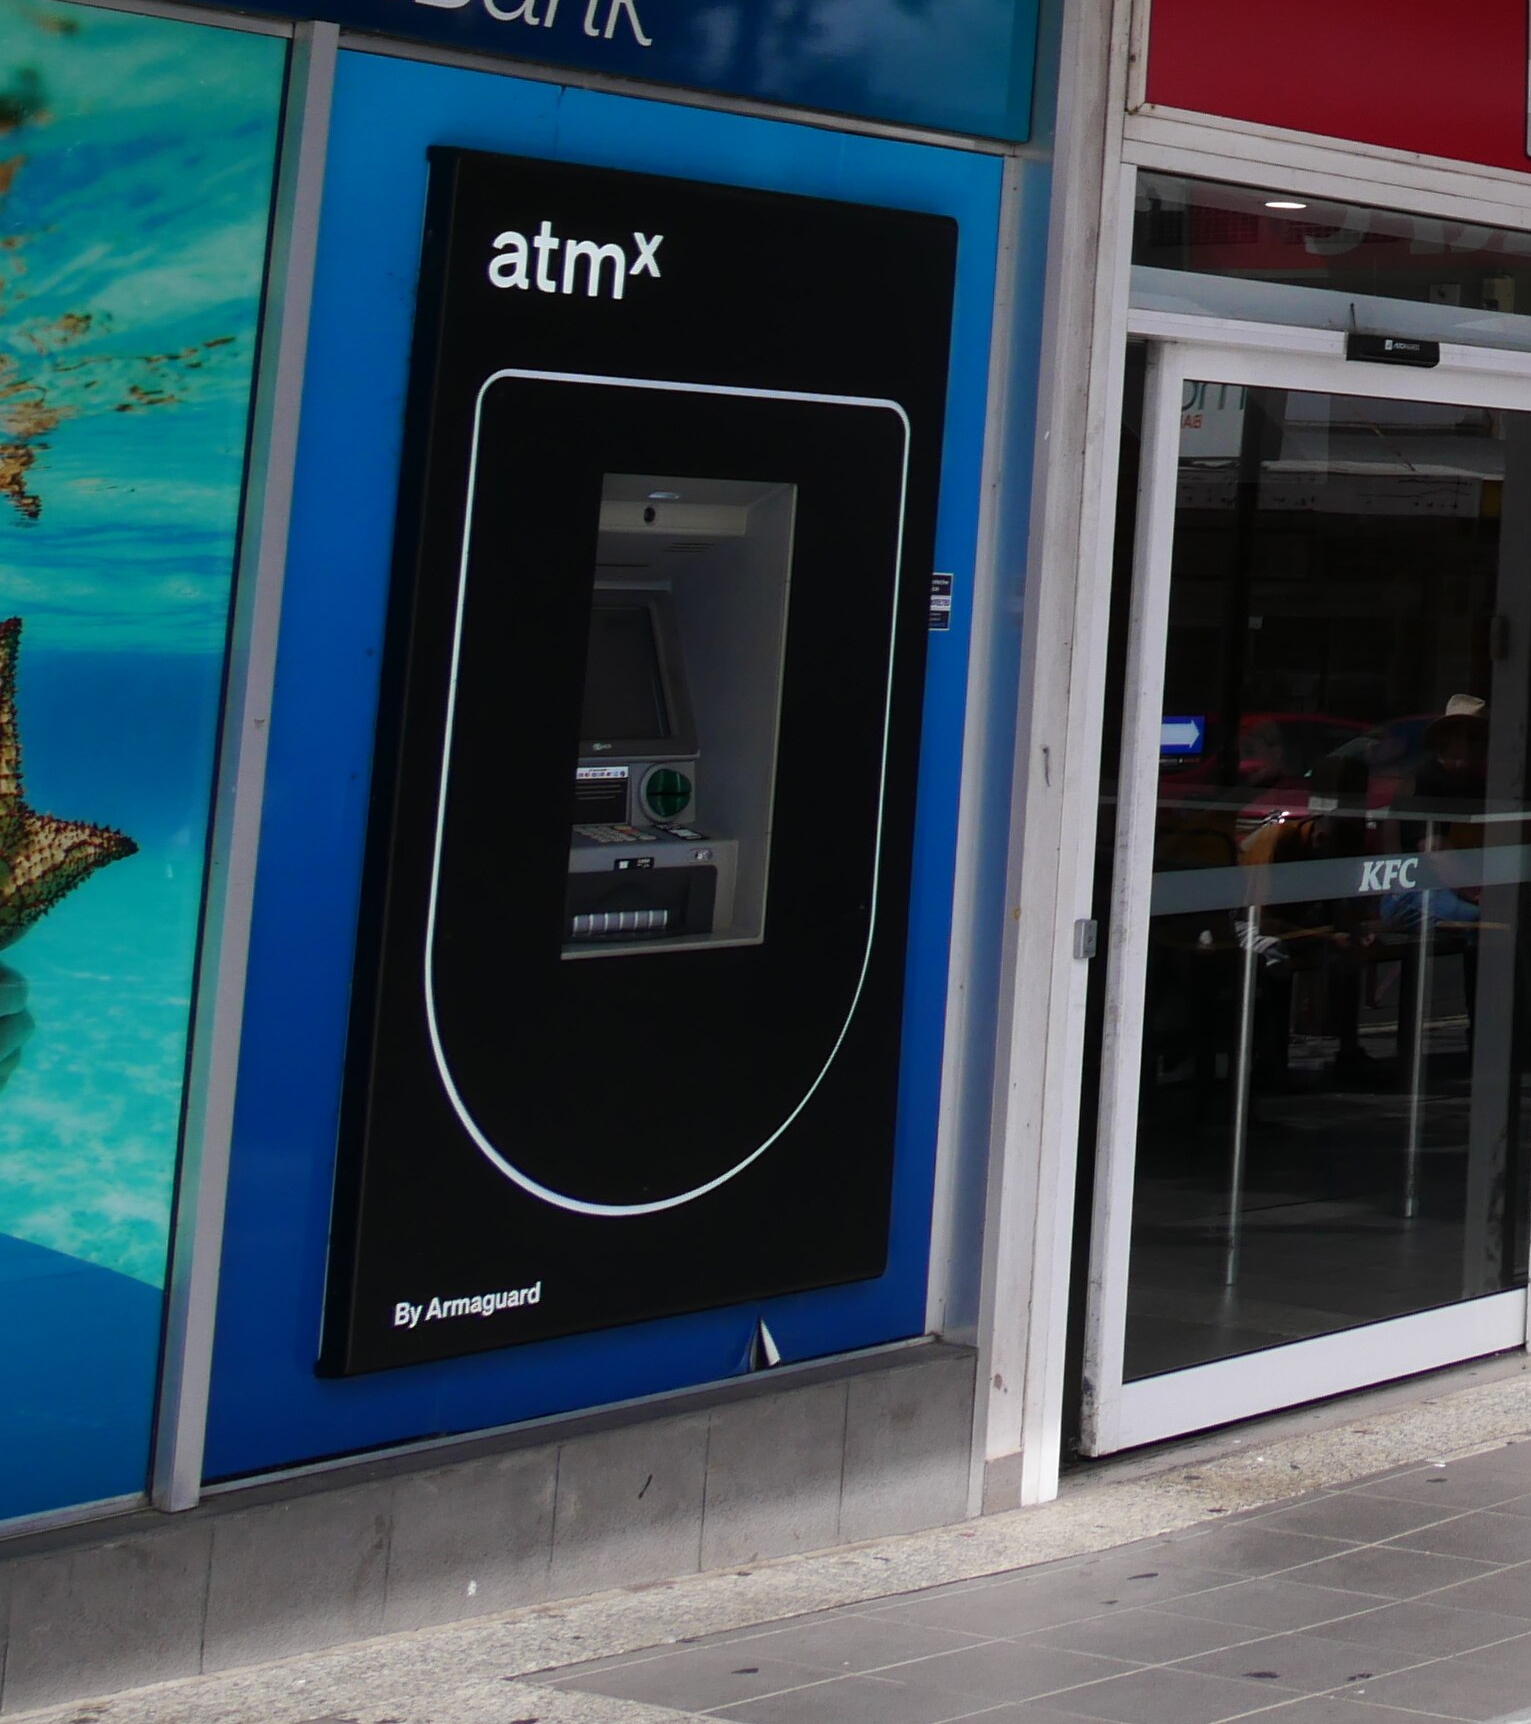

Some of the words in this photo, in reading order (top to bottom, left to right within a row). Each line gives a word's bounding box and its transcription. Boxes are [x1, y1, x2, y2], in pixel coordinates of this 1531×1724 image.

[1358, 857, 1418, 893] KFC
[394, 1302, 423, 1329] By
[424, 1280, 542, 1321] Armaguard
